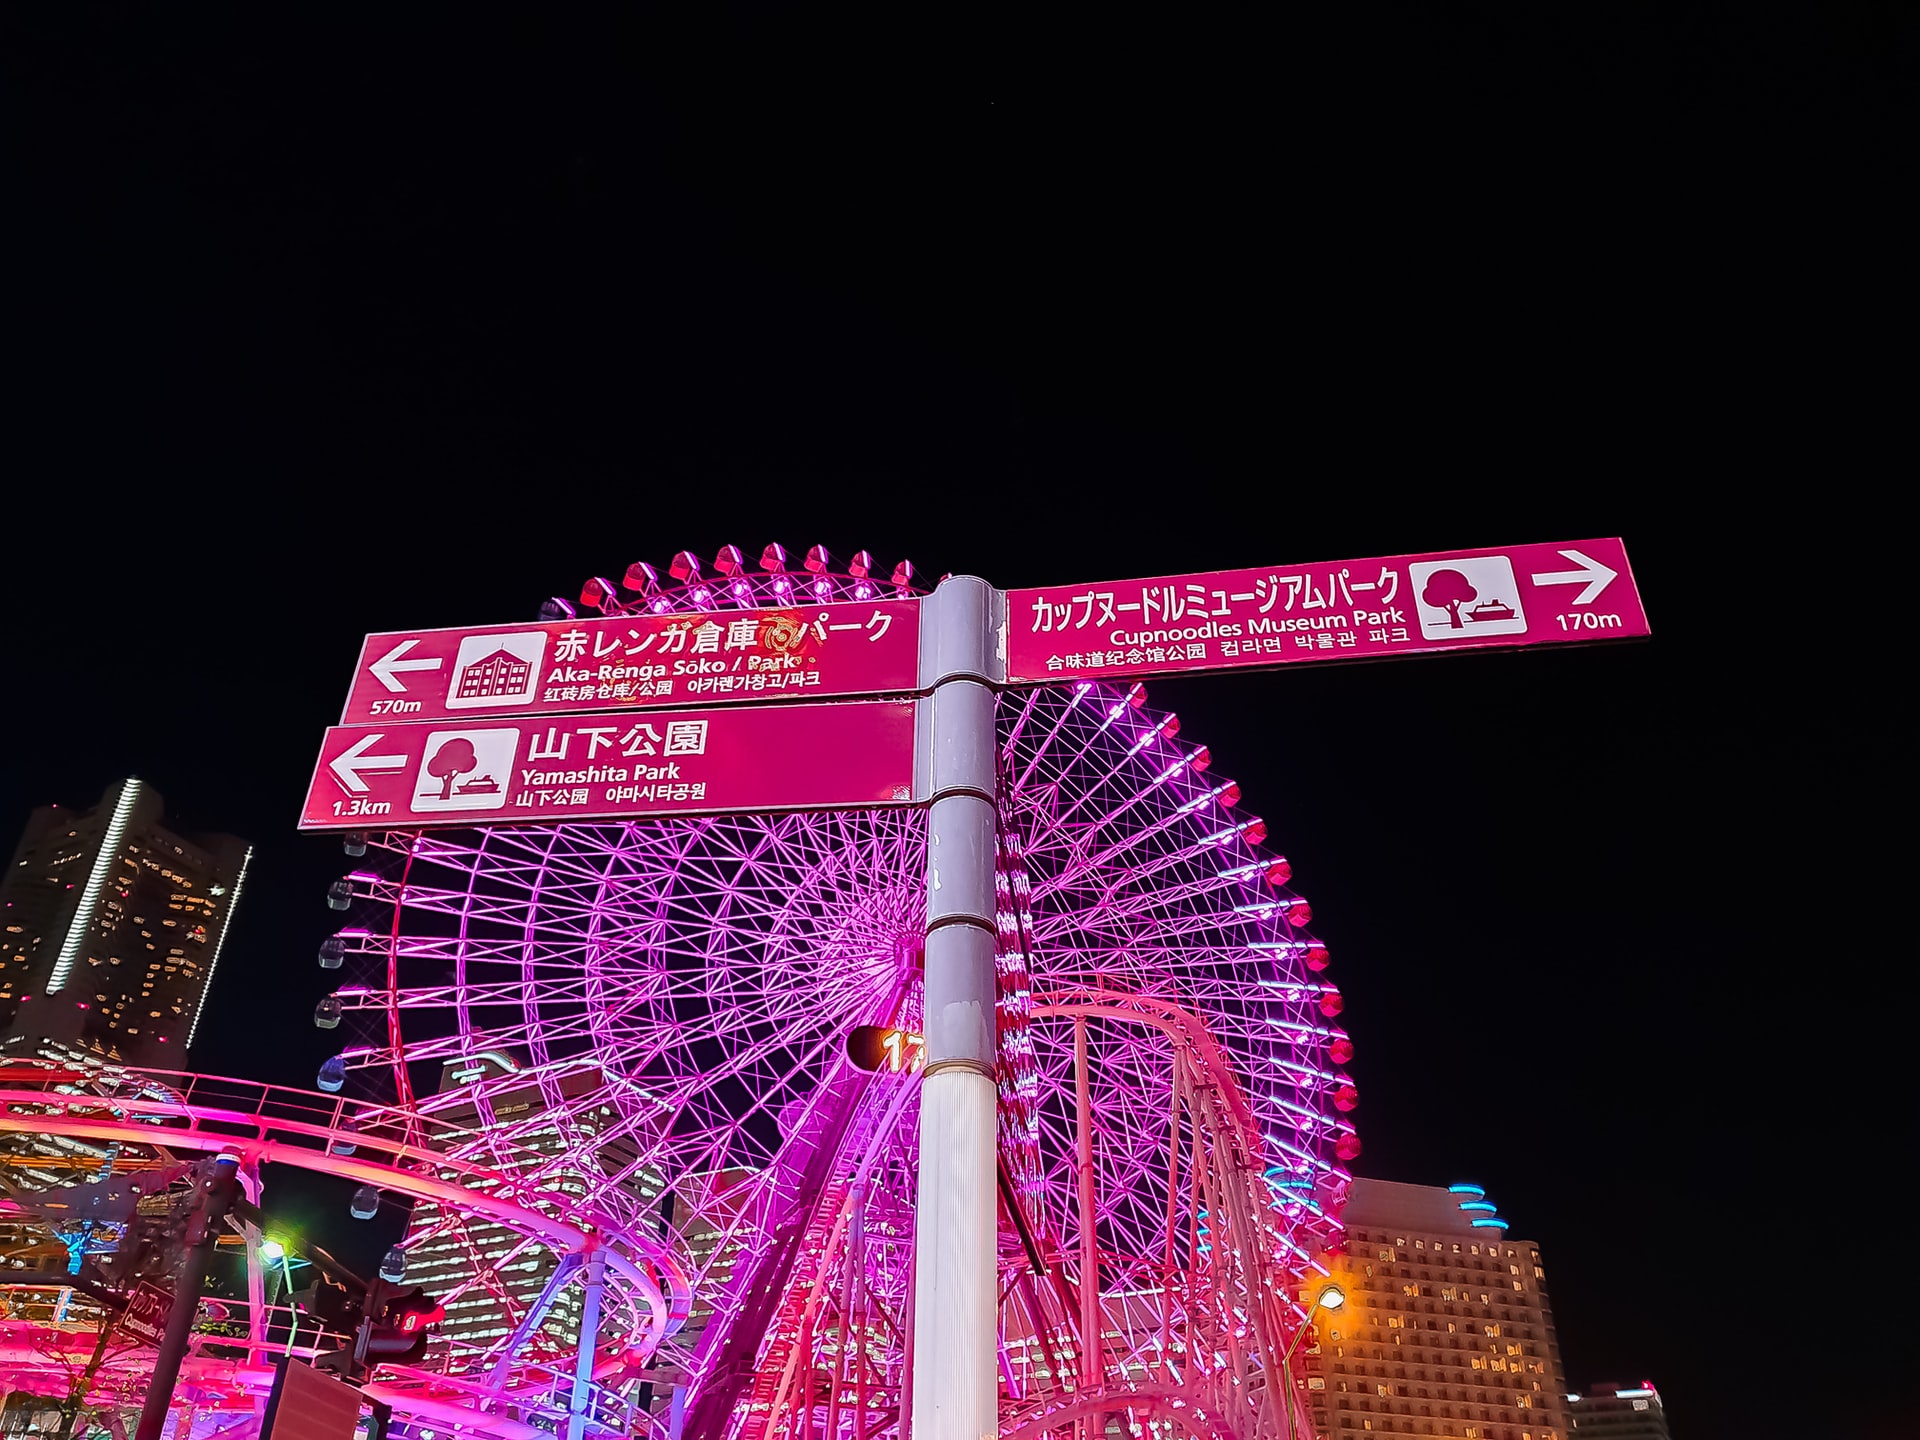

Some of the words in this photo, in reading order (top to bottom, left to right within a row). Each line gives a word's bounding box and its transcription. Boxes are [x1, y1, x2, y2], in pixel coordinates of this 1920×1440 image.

[1031, 566, 1398, 633] カップヌードルミュージアムパーク
[1110, 621, 1242, 647] Cupnoodles
[1248, 613, 1348, 635] Museum
[1353, 606, 1406, 626] Park
[1556, 612, 1622, 631] 170m
[1220, 636, 1282, 657] 컵라면
[1294, 630, 1357, 651] 박물관
[1368, 626, 1411, 645] 파크
[546, 664, 667, 684] Aka-Renga
[672, 656, 726, 676] Sōko
[748, 653, 796, 671] Park
[1045, 643, 1206, 671] 合味道纪念馆公园
[687, 670, 821, 694] 아카렌가창고/파크
[369, 699, 421, 715] 570m
[527, 719, 709, 762] 山下公園
[521, 764, 628, 786] Yamashita
[633, 762, 681, 781] Park
[515, 787, 590, 808] 山下公园
[605, 782, 706, 804] 야마시타공원
[332, 799, 391, 816] 1.3km
